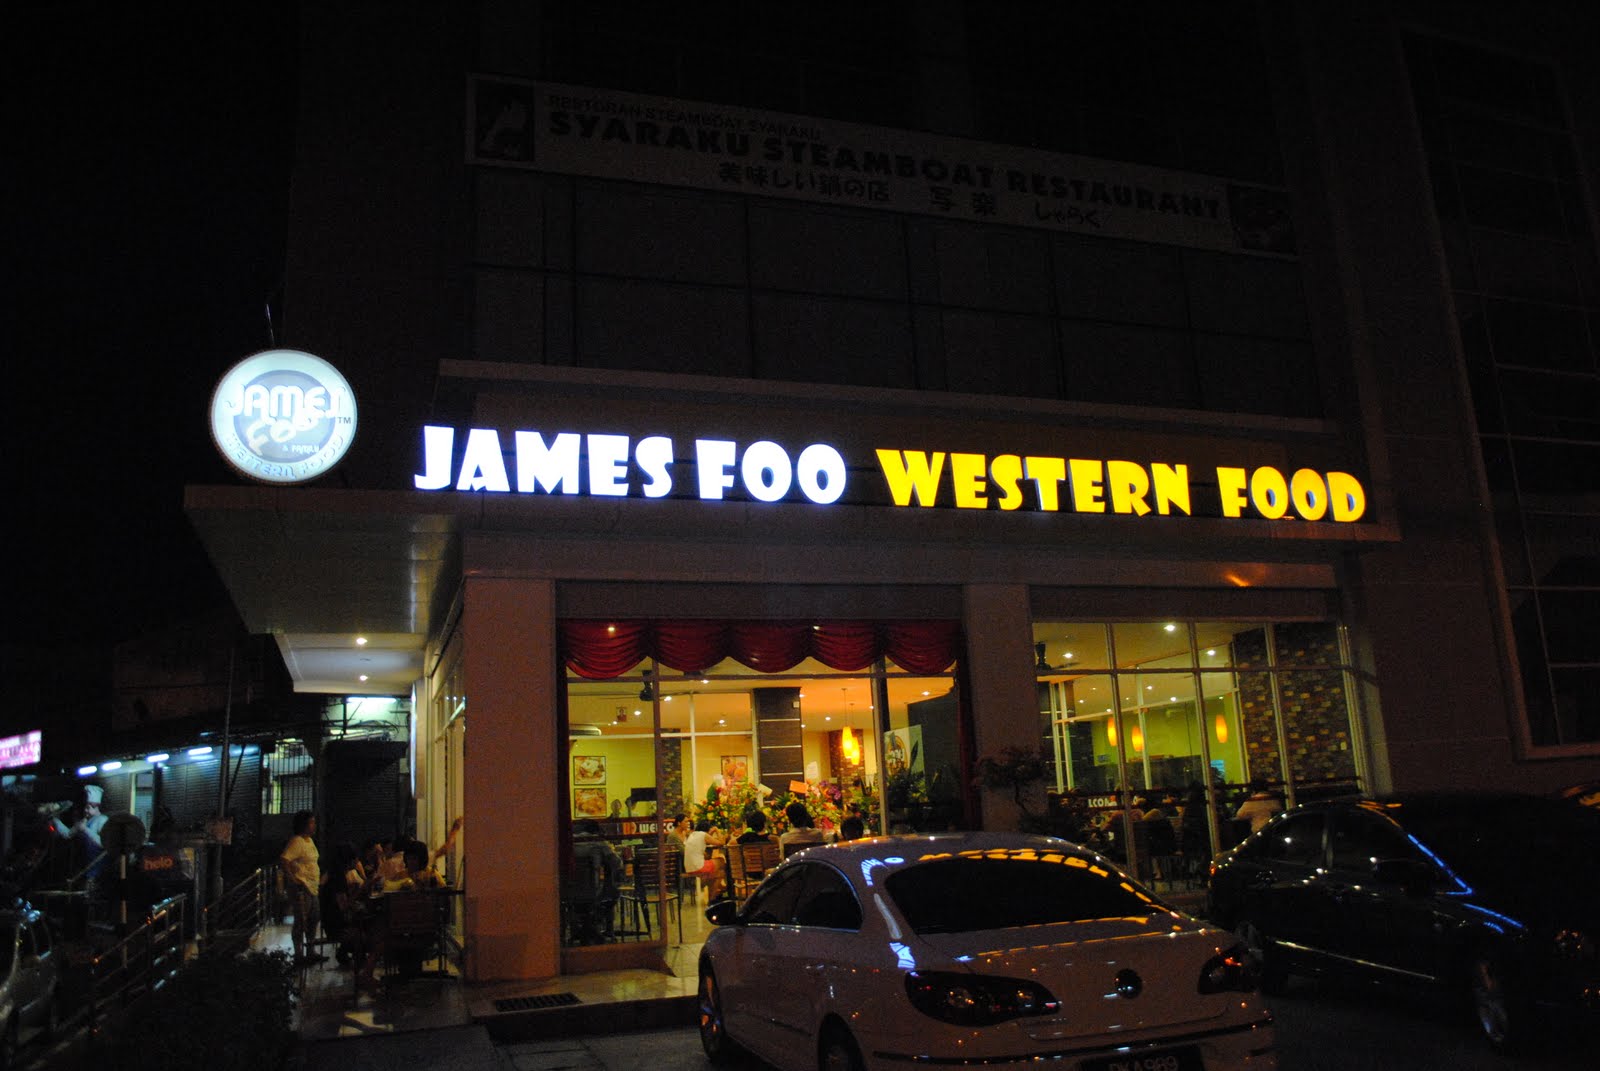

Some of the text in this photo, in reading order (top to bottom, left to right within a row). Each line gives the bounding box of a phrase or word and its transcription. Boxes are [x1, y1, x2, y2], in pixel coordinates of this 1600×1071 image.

[549, 94, 641, 117] RESTORAN
[645, 107, 743, 130] STEAMBOAT
[549, 111, 1219, 219] SYARAKU STEAMBOAT RESTAURANT
[414, 425, 1366, 522] JAMES FOO WESTERN FOOD
